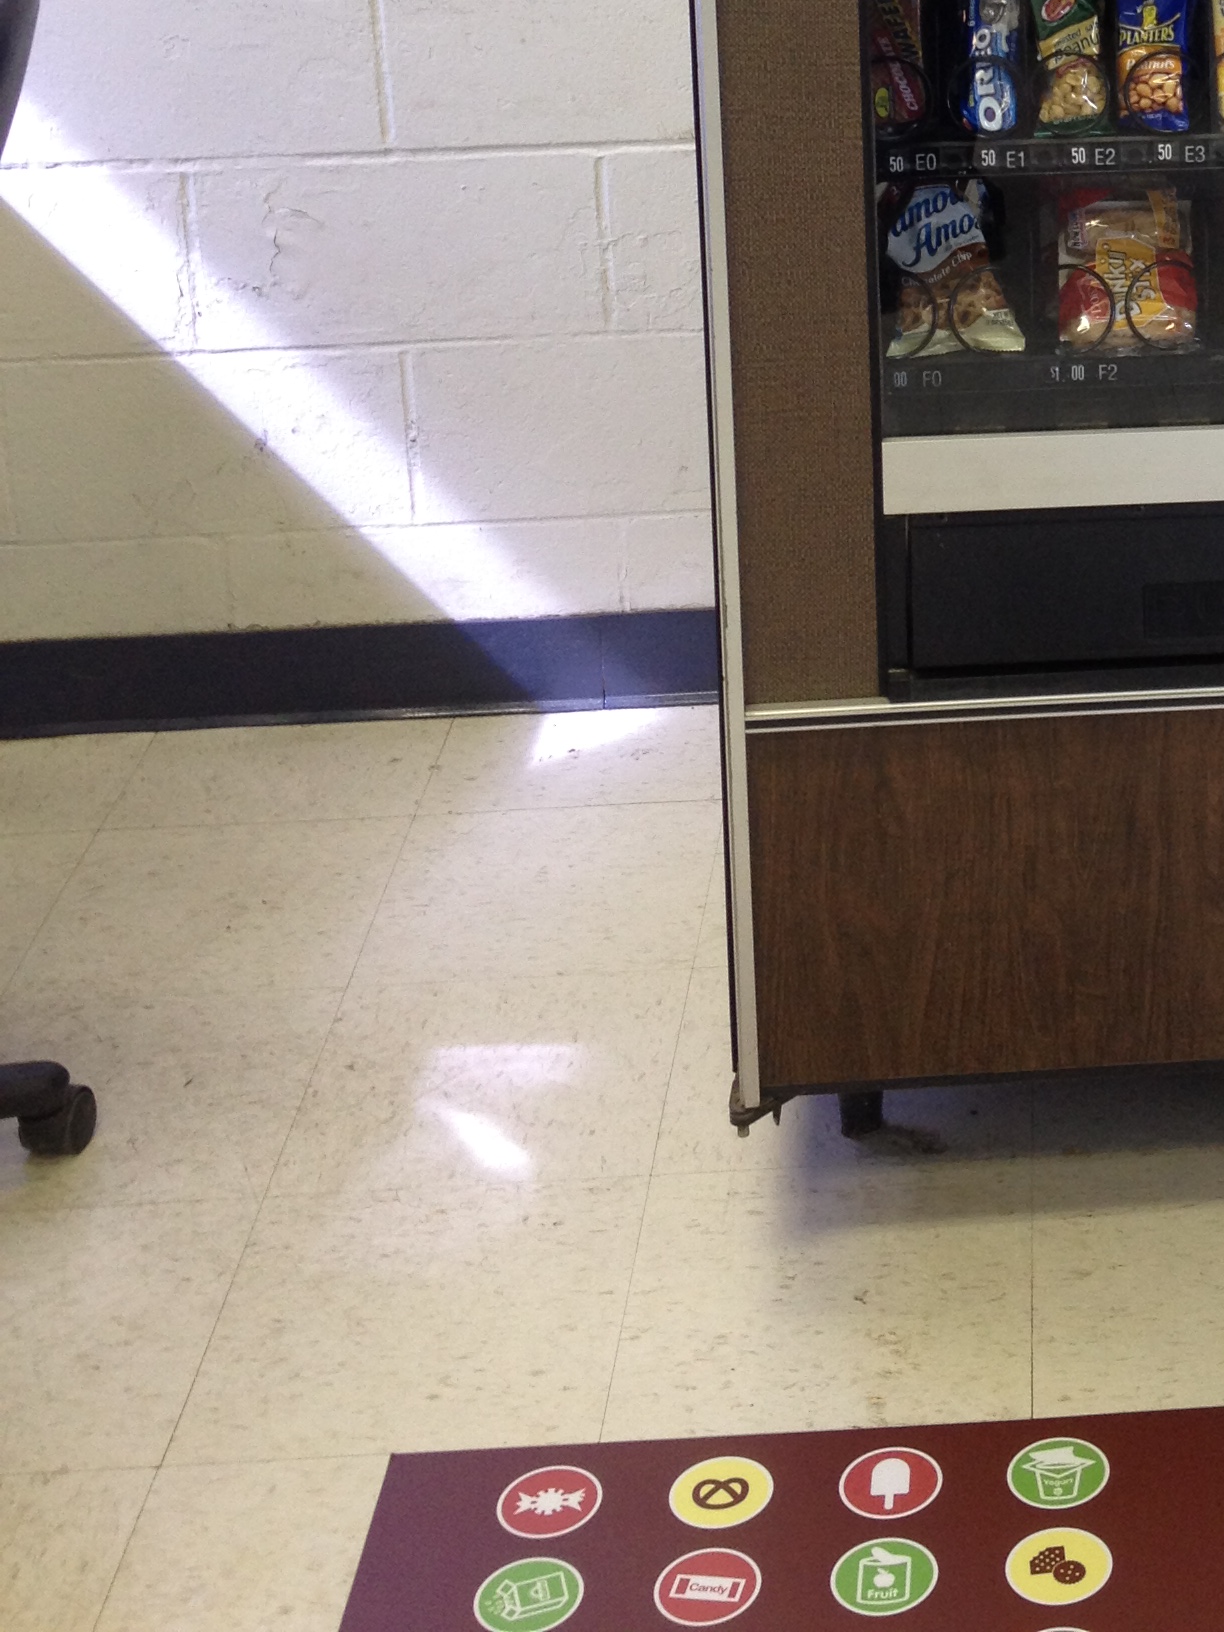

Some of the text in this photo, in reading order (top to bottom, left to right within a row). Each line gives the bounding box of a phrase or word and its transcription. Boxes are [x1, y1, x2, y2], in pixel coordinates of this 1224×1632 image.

[1119, 25, 1175, 46] PLANTERS
[916, 154, 937, 171] E0
[1006, 151, 1025, 168] E1
[1095, 149, 1116, 166] E2
[1185, 146, 1206, 163] E3
[922, 370, 942, 387] F0
[1099, 364, 1118, 380] F2
[1043, 1476, 1075, 1487] Yogurt
[689, 1580, 728, 1595] Candy
[867, 1587, 899, 1600] Fruit
